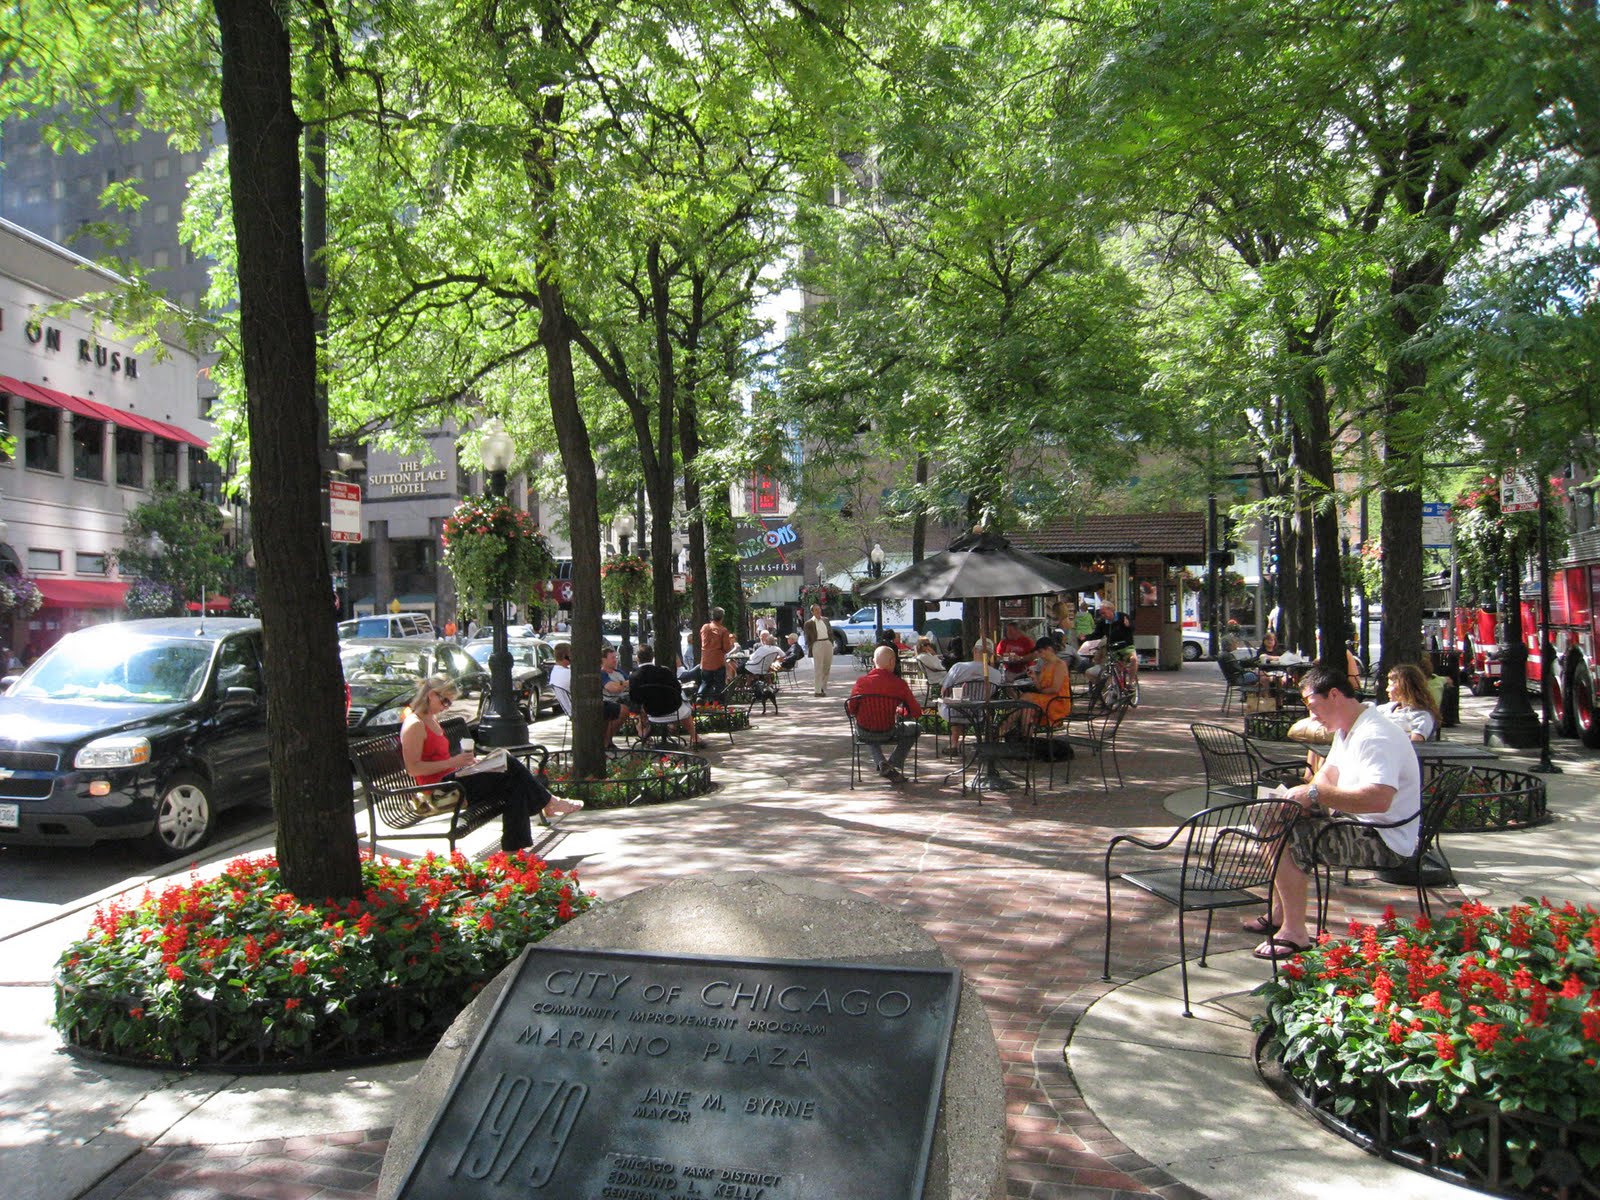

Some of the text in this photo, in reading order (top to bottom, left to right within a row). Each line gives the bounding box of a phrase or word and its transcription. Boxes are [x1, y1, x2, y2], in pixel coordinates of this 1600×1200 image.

[25, 320, 139, 379] ON RUSH
[369, 470, 447, 485] SUTTON PLACE
[399, 461, 419, 472] THE
[391, 483, 426, 494] HOTEL
[1516, 493, 1533, 502] STOP
[545, 969, 911, 1017] CITY OF CHICAGO
[532, 1002, 826, 1036] COMMUNITY IMPROVEMENT PROGRAM
[516, 1025, 811, 1069] MARIANO PLAZA
[632, 1106, 692, 1124] MAYOR
[640, 1088, 816, 1120] JANE M. BYRNE
[449, 1072, 589, 1189] 1979
[606, 1171, 678, 1190] EDMUND
[713, 1183, 765, 1200] KELLY
[612, 1158, 782, 1188] CHICAGO PARK DISTRICT
[601, 1186, 657, 1200] GENERAL
